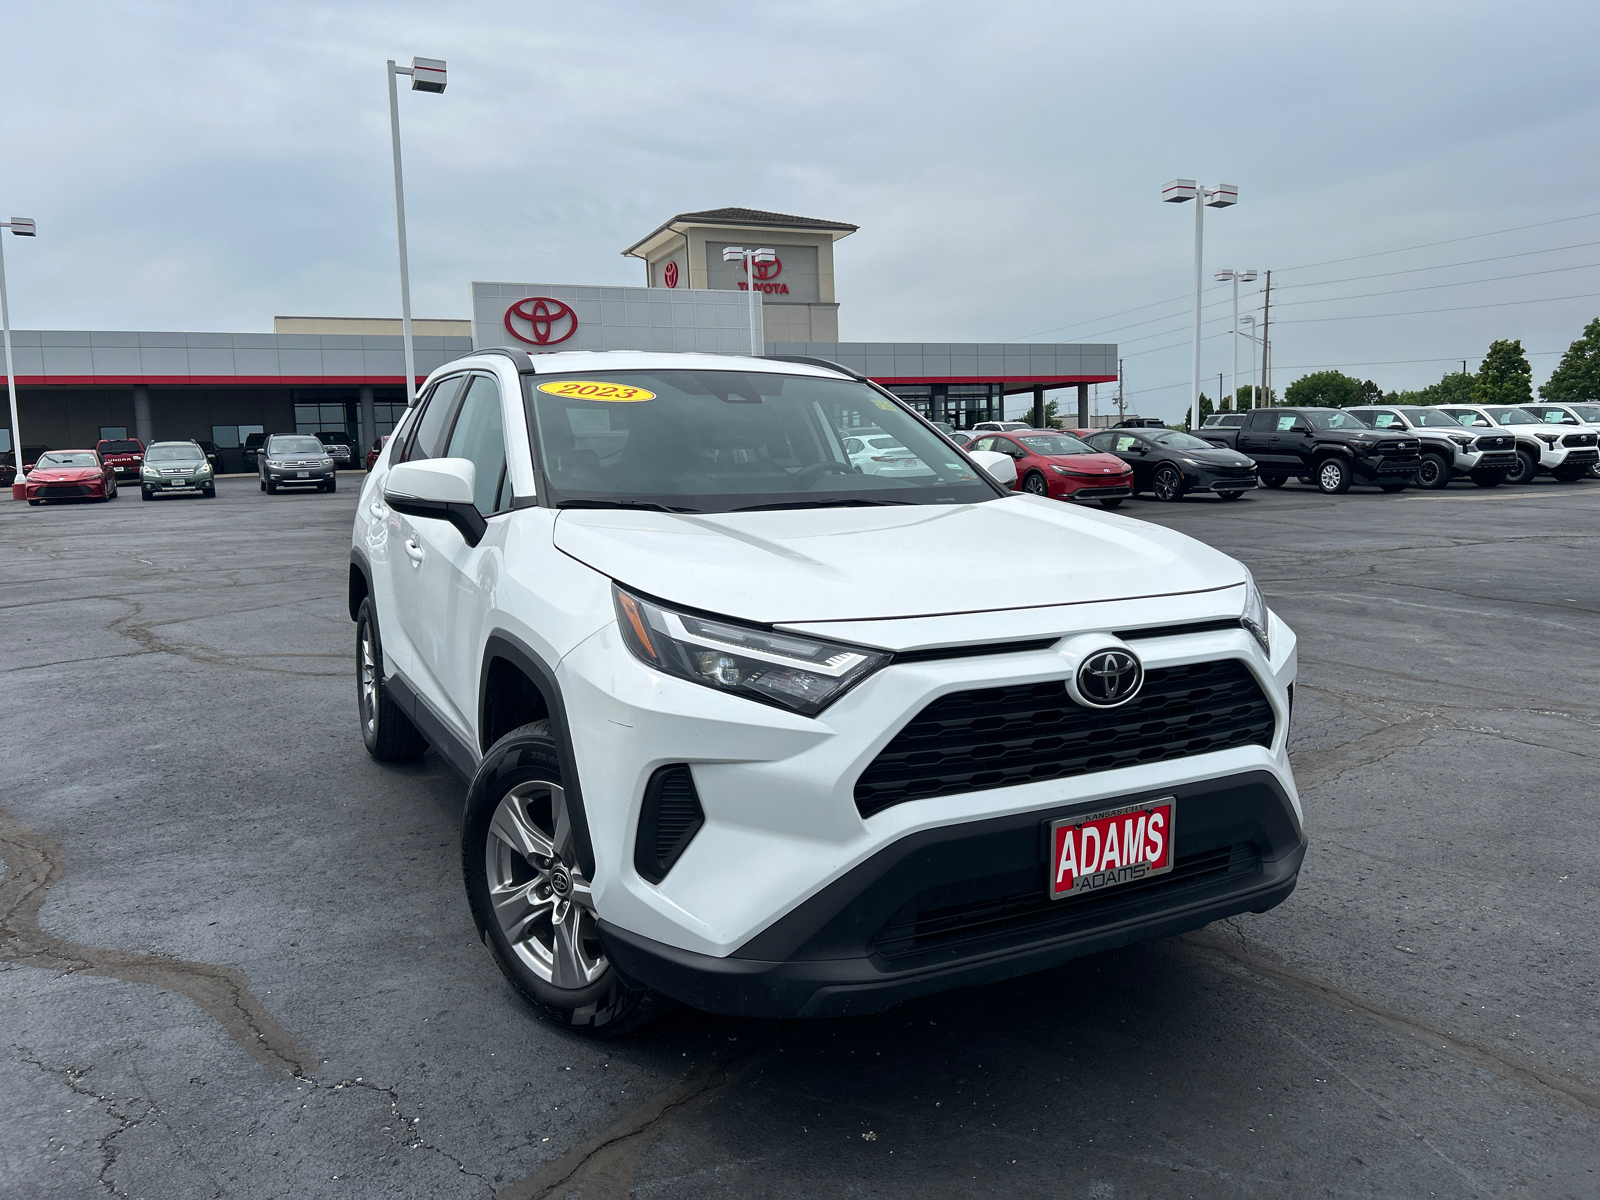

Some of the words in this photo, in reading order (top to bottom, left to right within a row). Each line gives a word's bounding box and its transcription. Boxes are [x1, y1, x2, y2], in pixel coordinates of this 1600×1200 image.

[556, 383, 639, 399] 2023
[1085, 808, 1123, 821] KANSAS
[1125, 804, 1144, 814] CITY
[1056, 812, 1164, 883] ADAMS
[1079, 863, 1146, 892] ADAMS
